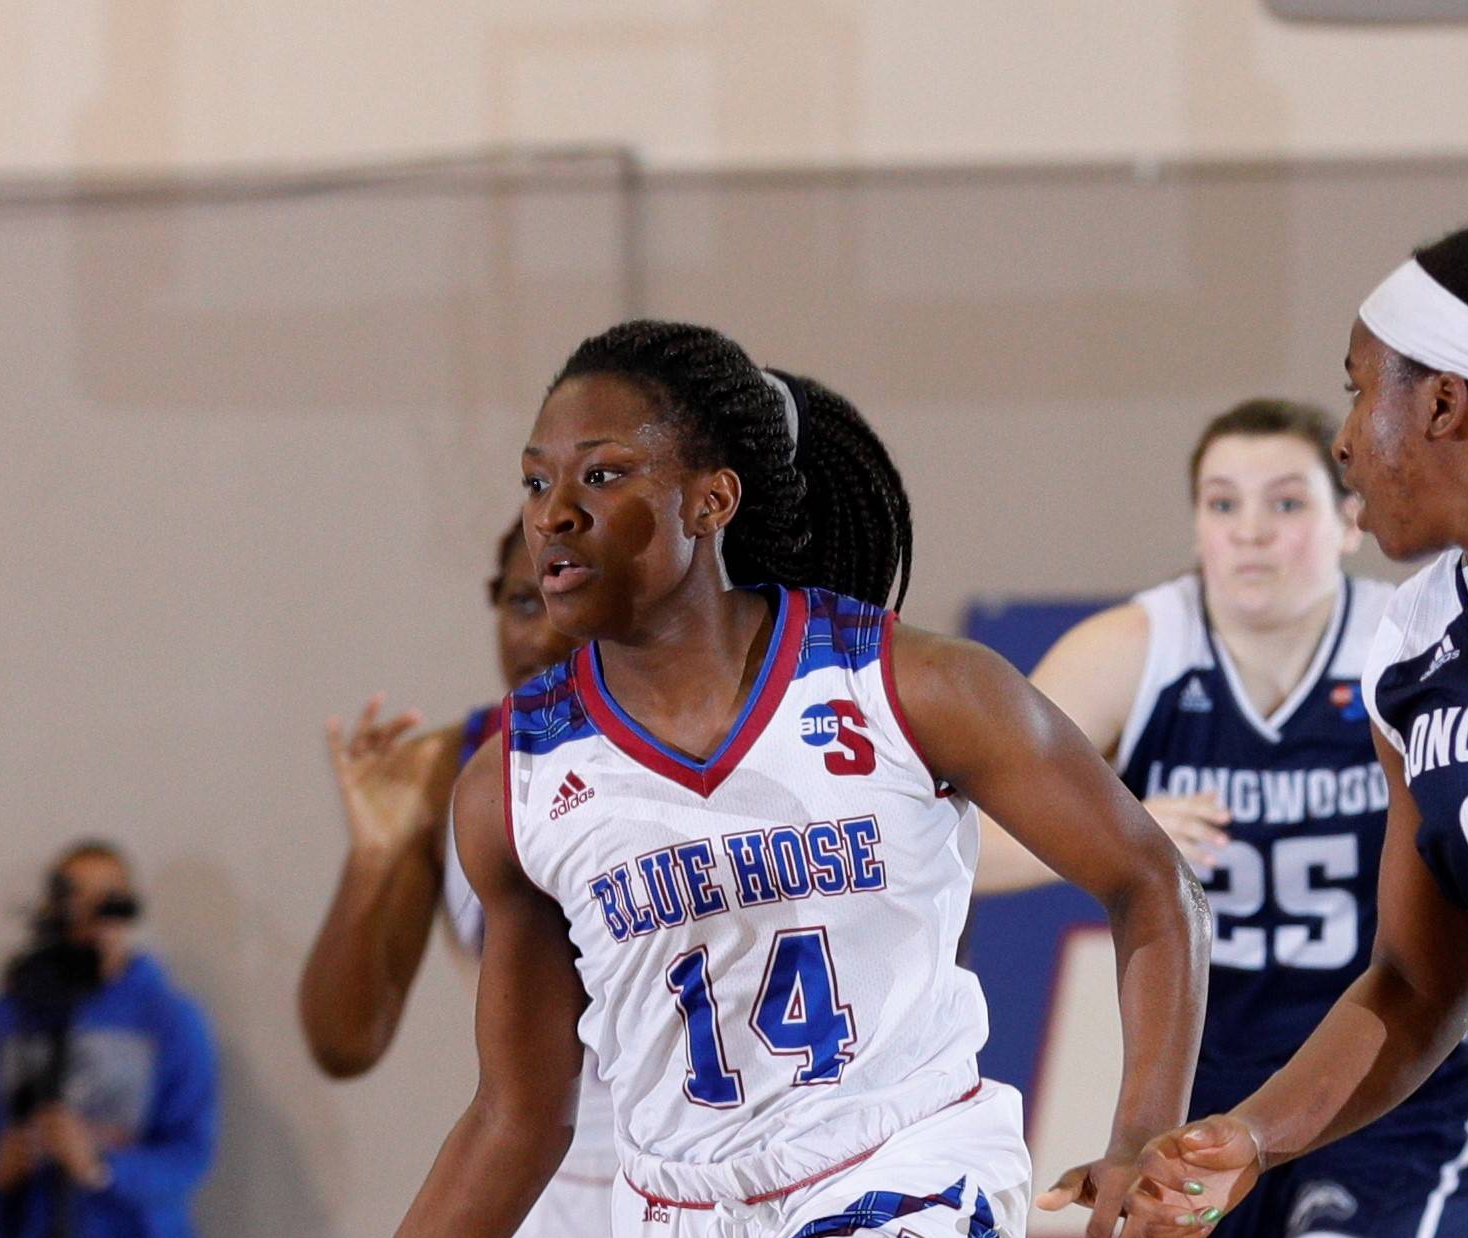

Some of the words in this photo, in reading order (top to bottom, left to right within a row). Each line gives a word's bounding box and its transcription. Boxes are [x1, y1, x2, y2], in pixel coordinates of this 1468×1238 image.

[800, 715, 838, 736] BIG
[823, 699, 876, 776] S
[549, 786, 595, 821] adidas
[588, 839, 729, 943] BLUE
[721, 814, 888, 908] HOSE
[1207, 834, 1358, 972] 25
[665, 926, 858, 1110] 14
